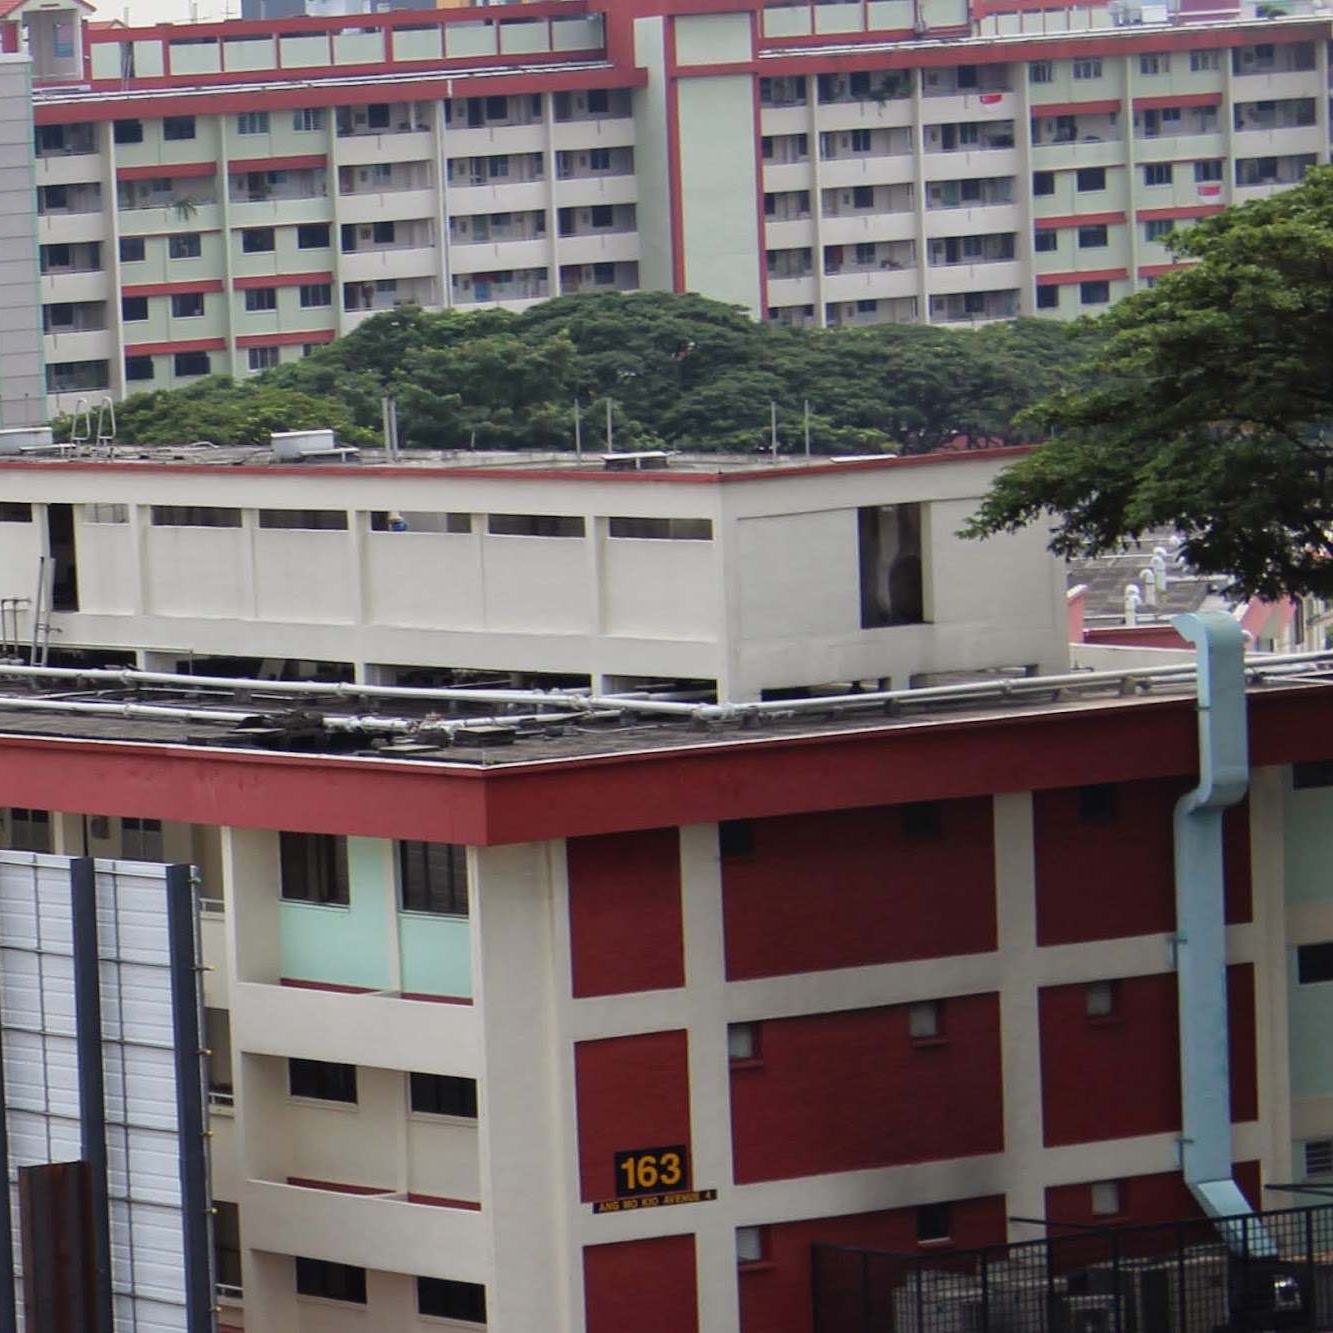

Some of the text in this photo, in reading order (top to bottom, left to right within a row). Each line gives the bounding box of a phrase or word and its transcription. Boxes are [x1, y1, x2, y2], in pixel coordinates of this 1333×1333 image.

[621, 1152, 682, 1189] 163
[599, 1190, 711, 1211] ANG MO KIO AVENUE 4
